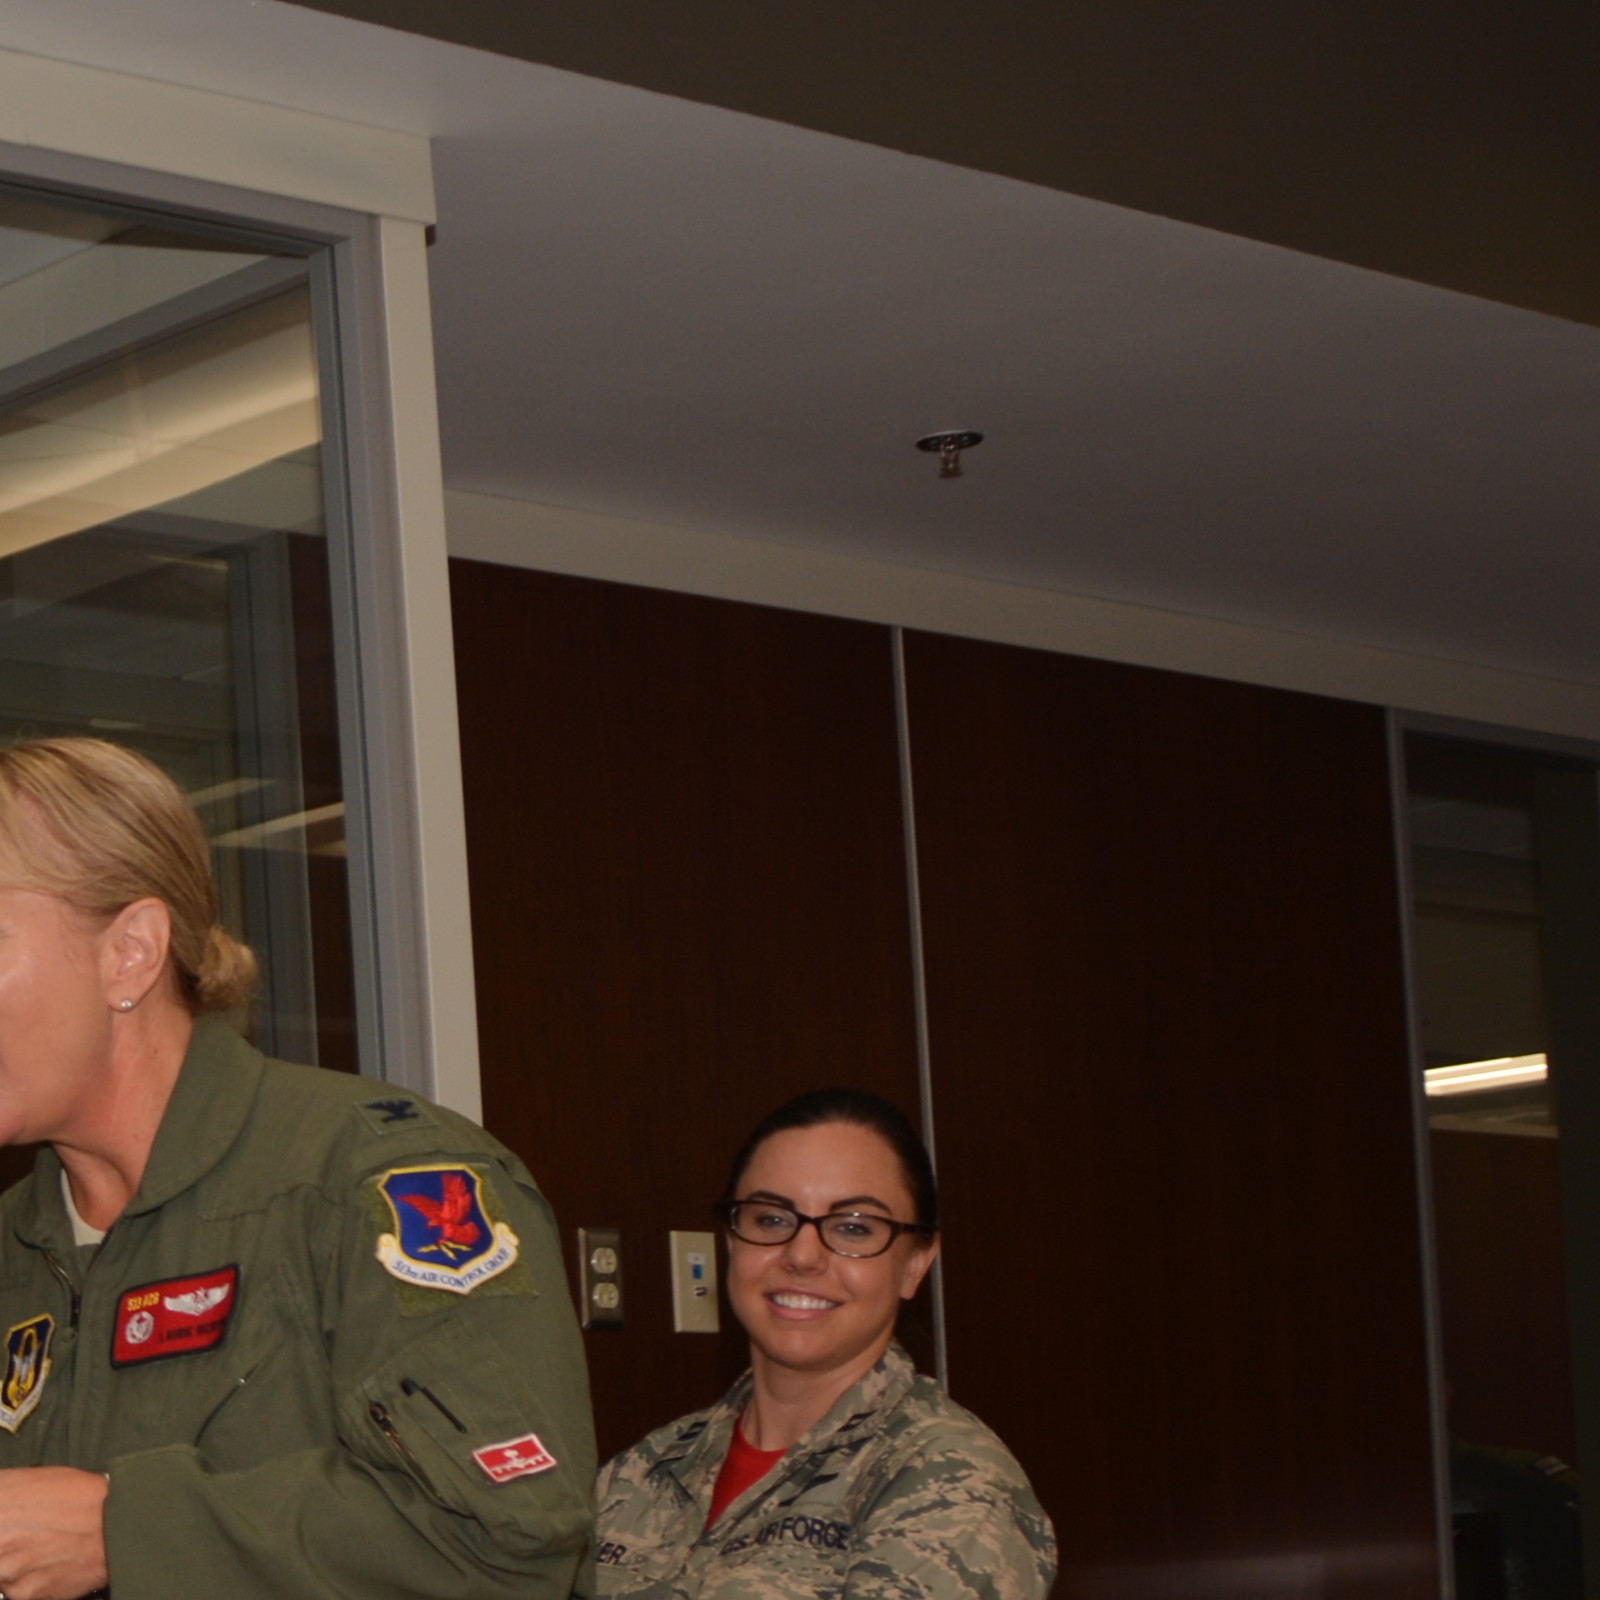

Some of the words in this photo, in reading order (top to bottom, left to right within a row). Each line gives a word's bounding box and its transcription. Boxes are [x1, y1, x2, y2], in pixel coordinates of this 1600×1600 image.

[420, 1272, 438, 1282] AIR
[440, 1267, 486, 1288] CONTROL
[485, 1248, 509, 1271] GROUP
[779, 1516, 852, 1551] FORCE
